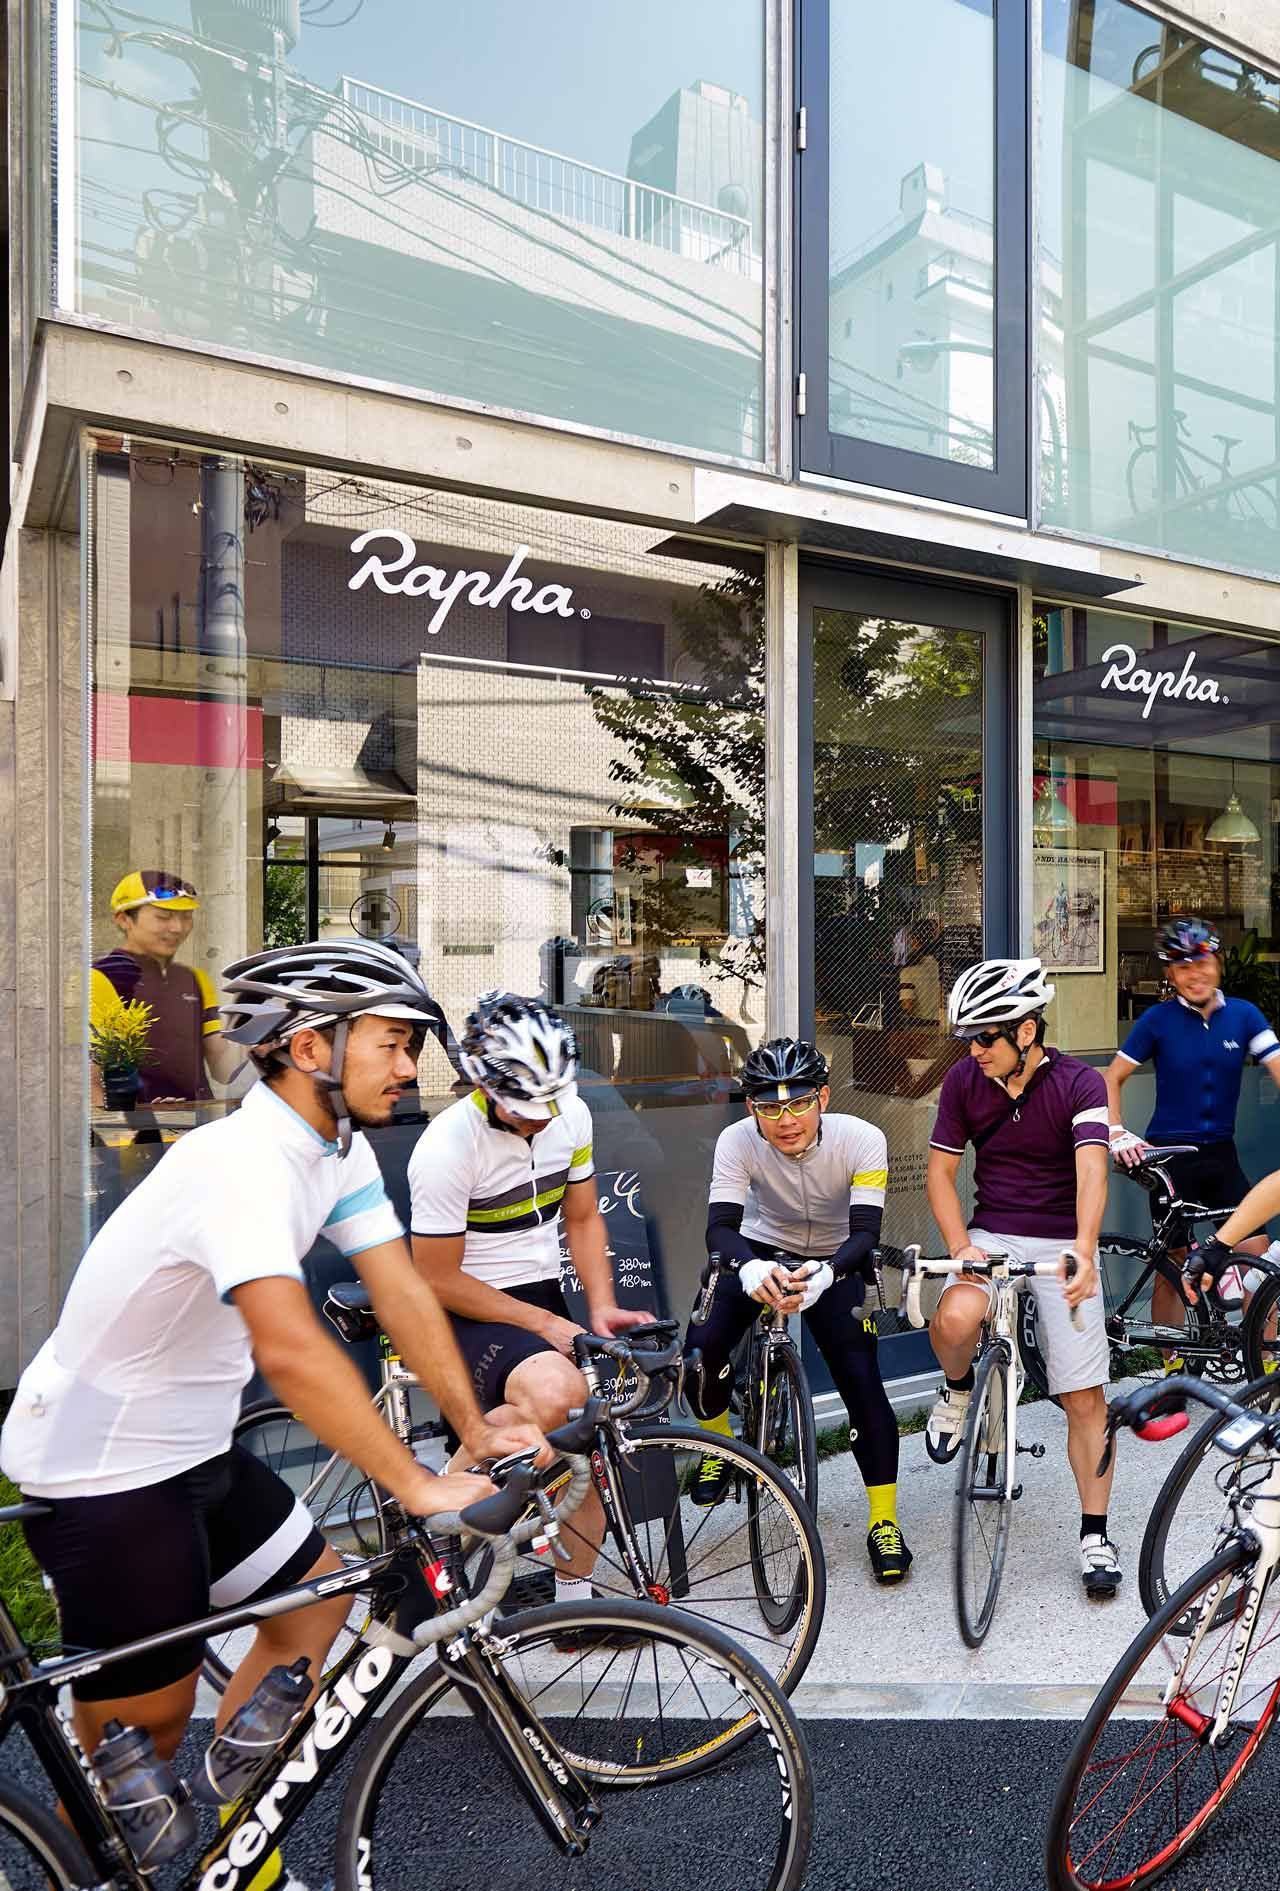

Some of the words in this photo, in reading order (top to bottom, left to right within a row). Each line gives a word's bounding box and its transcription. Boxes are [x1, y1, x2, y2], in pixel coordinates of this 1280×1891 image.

[348, 528, 575, 634] Rapha
[1101, 644, 1220, 719] Rapha
[316, 1568, 371, 1597] S3
